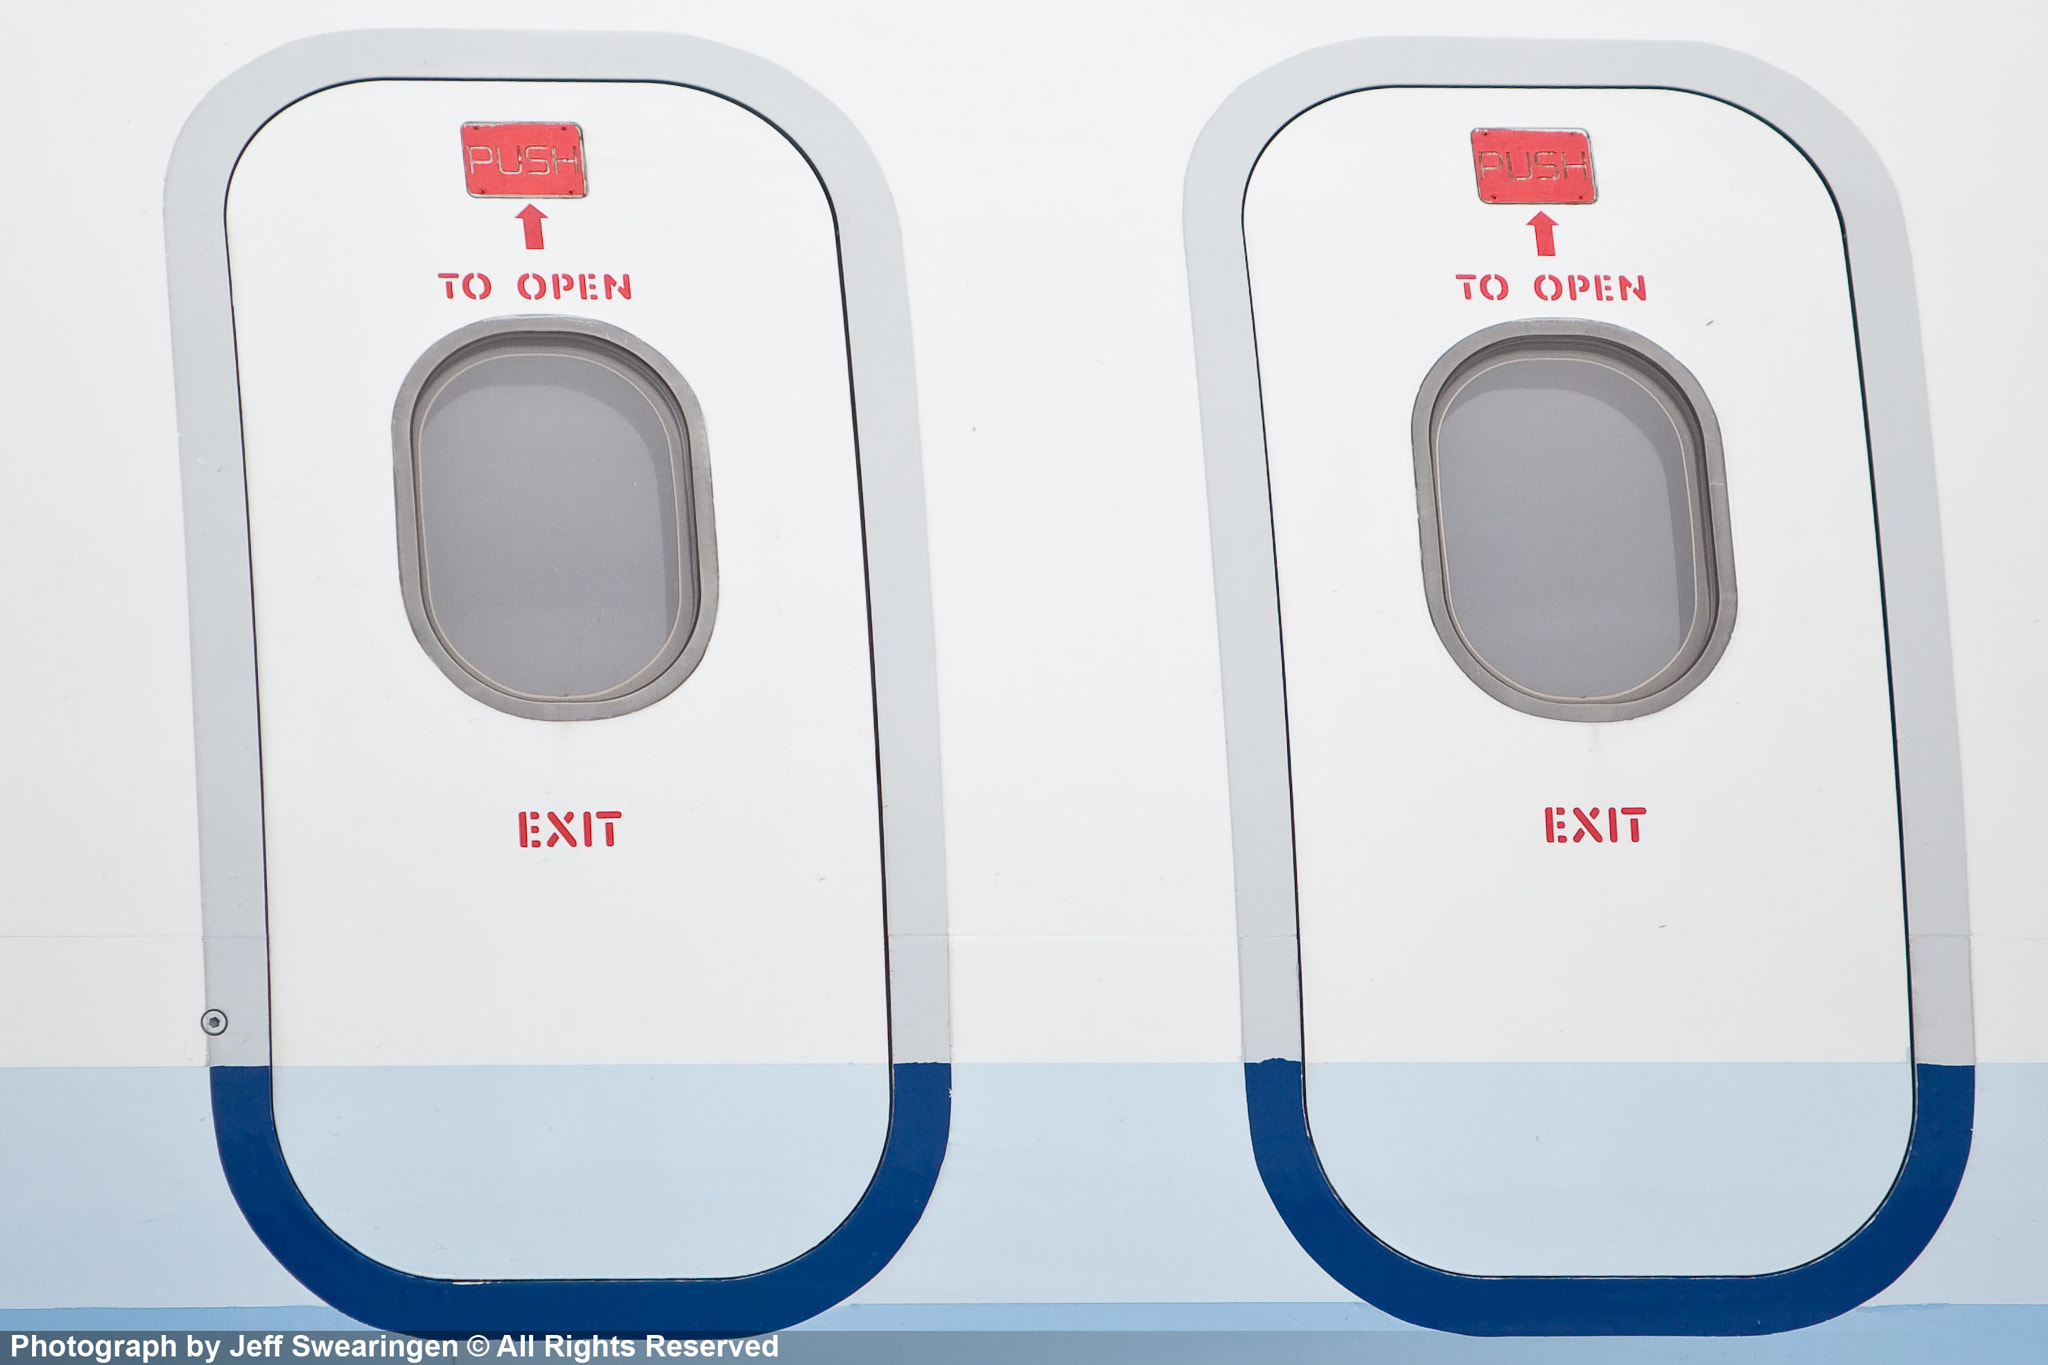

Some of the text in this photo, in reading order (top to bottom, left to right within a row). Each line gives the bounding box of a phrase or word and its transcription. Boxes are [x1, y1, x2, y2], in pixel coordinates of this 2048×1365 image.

[466, 145, 580, 176] PUSH
[1477, 151, 1589, 181] PUSH
[437, 272, 632, 301] TO OPEN
[1455, 273, 1647, 302] TO OPEN
[518, 810, 623, 848] EXIT
[1544, 806, 1648, 844] EXIT
